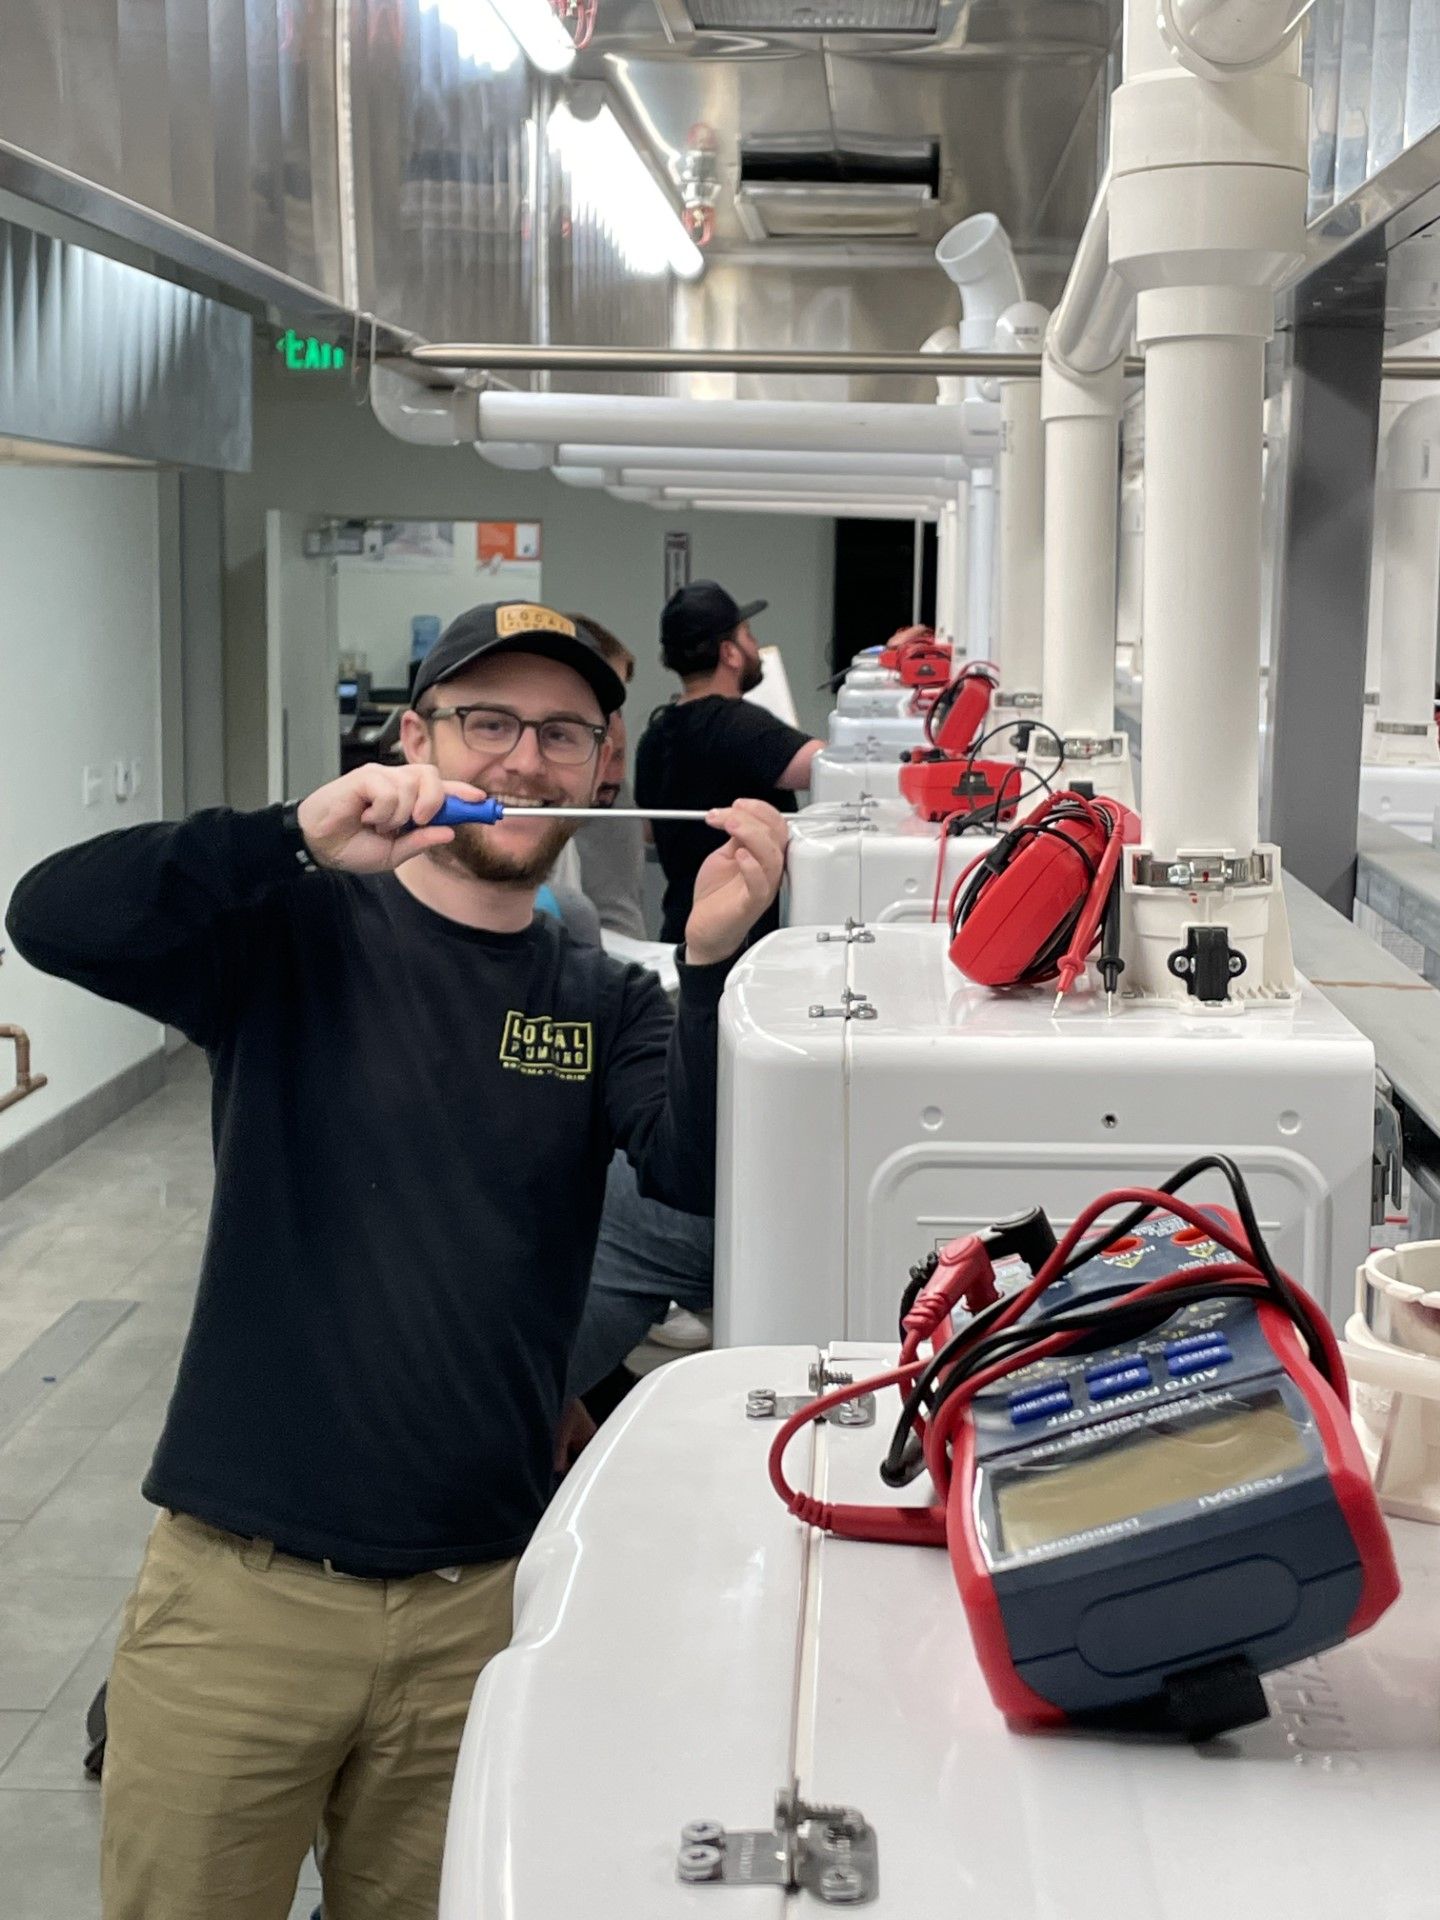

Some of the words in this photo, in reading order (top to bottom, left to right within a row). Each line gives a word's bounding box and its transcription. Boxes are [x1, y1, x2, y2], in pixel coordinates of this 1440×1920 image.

[512, 1018, 584, 1049] LOCAL
[1163, 1367, 1219, 1393] AUTO
[1086, 1385, 1160, 1415] POWER
[1044, 1407, 1085, 1427] OFF
